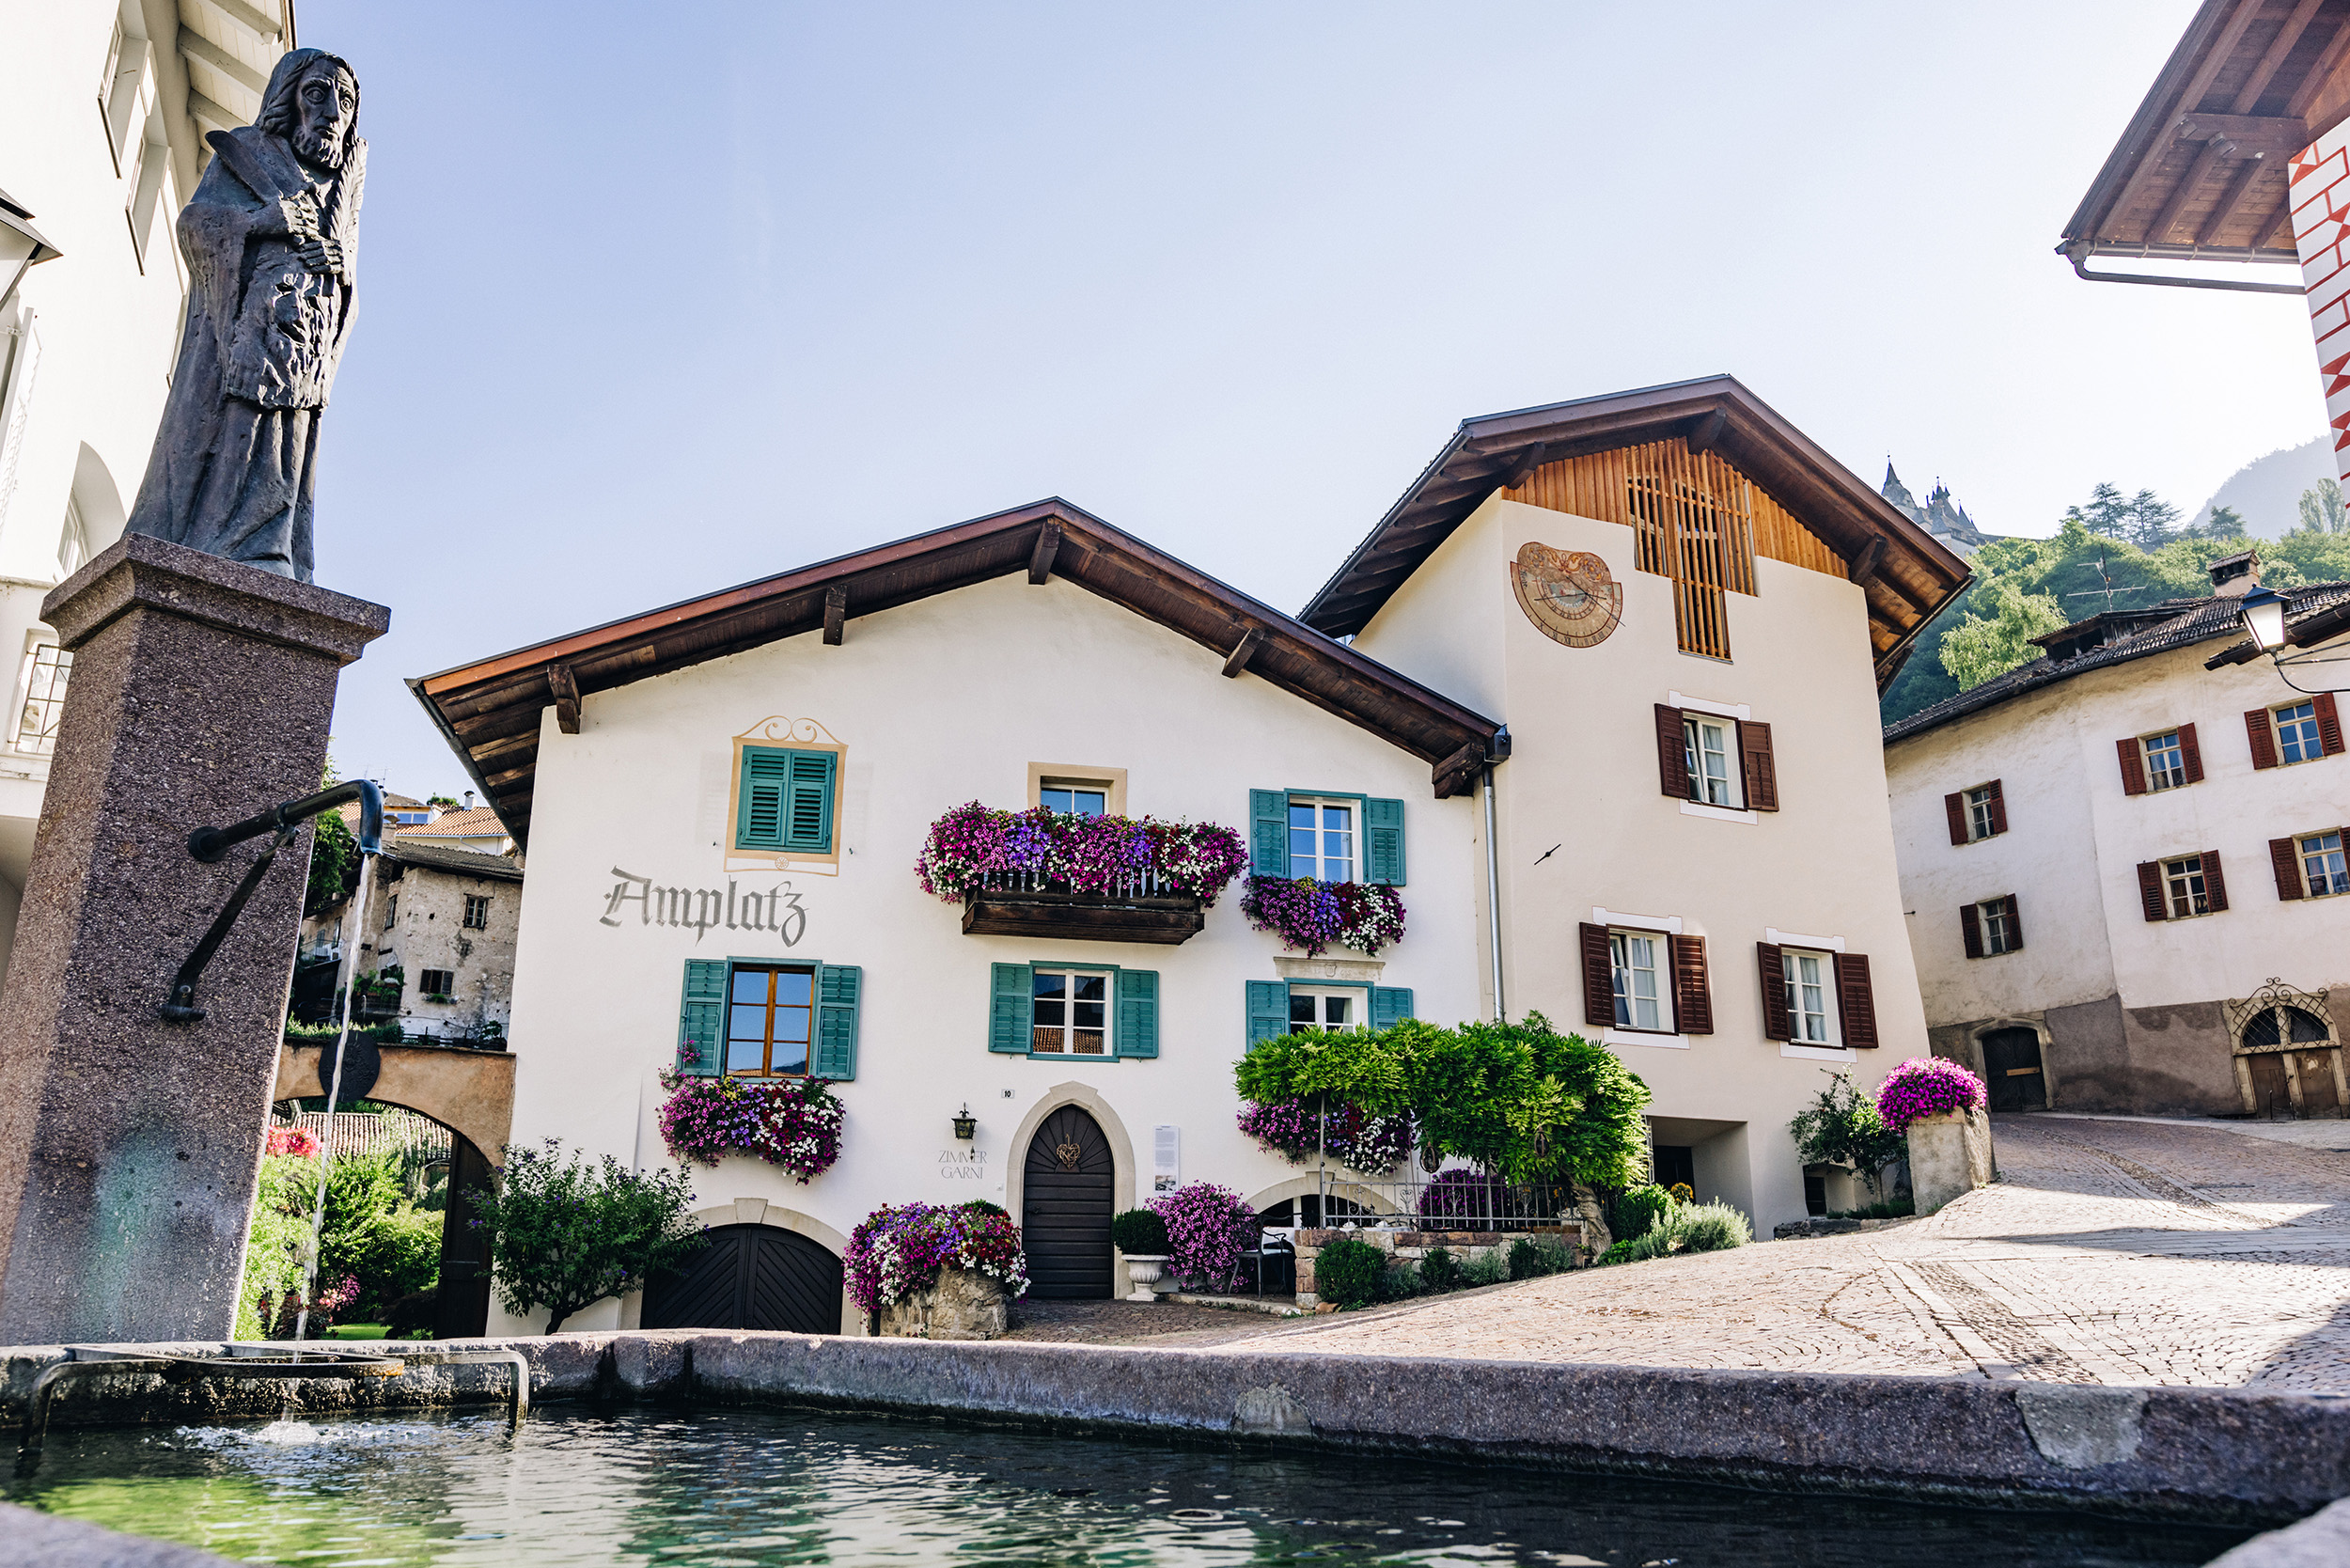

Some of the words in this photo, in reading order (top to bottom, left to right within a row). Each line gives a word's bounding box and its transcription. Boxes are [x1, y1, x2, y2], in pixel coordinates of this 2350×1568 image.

[599, 865, 809, 948] Amplatz
[1004, 1090, 1011, 1098] 10
[938, 1150, 987, 1164] ZIMMER
[941, 1166, 983, 1179] GARNI
